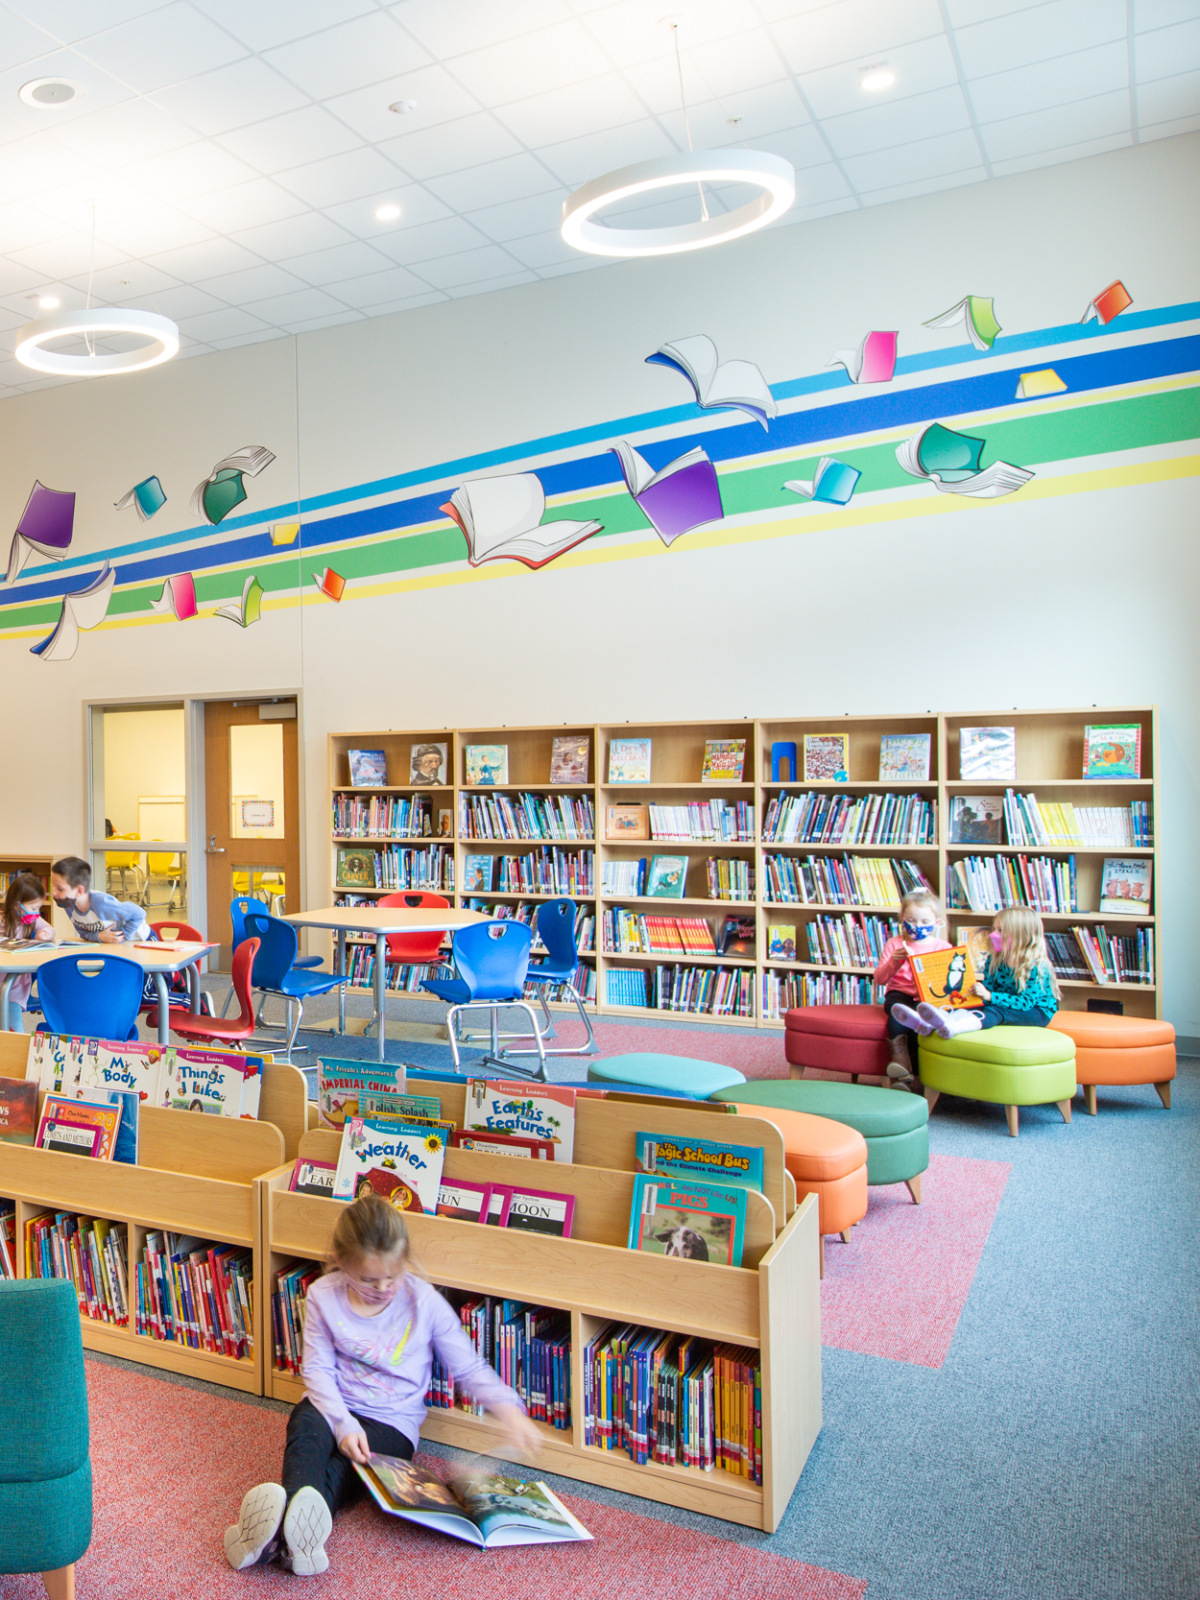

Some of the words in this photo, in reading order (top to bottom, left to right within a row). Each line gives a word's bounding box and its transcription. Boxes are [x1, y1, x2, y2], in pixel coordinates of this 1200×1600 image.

[342, 870, 369, 880] CARVER
[186, 1052, 205, 1062] Learning
[206, 1055, 224, 1064] Ladders
[104, 1067, 137, 1089] Body
[178, 1065, 225, 1085] Things
[360, 1068, 394, 1078] Adventures
[321, 1078, 365, 1091] IMPERIAL
[499, 1084, 523, 1094] Learning
[526, 1087, 548, 1096] Ladders
[400, 1103, 429, 1118] Splash
[491, 1099, 544, 1121] Earth's
[93, 1112, 115, 1131] 20
[121, 1120, 135, 1131] world
[486, 1115, 553, 1139] Features
[376, 1123, 398, 1132] Learning
[401, 1126, 421, 1135] Ladders
[62, 1132, 73, 1142] AND
[72, 1133, 93, 1146] METEORS
[663, 1142, 677, 1150] The
[355, 1141, 428, 1170] Weather
[683, 1146, 723, 1166] School
[724, 1153, 751, 1171] Bus
[679, 1163, 706, 1172] Climate
[707, 1167, 742, 1177] Challenge
[310, 1174, 336, 1187] EAR
[682, 1184, 693, 1192] Are
[694, 1186, 710, 1195] NOT
[711, 1189, 724, 1199] Like
[669, 1191, 709, 1209] PIGS
